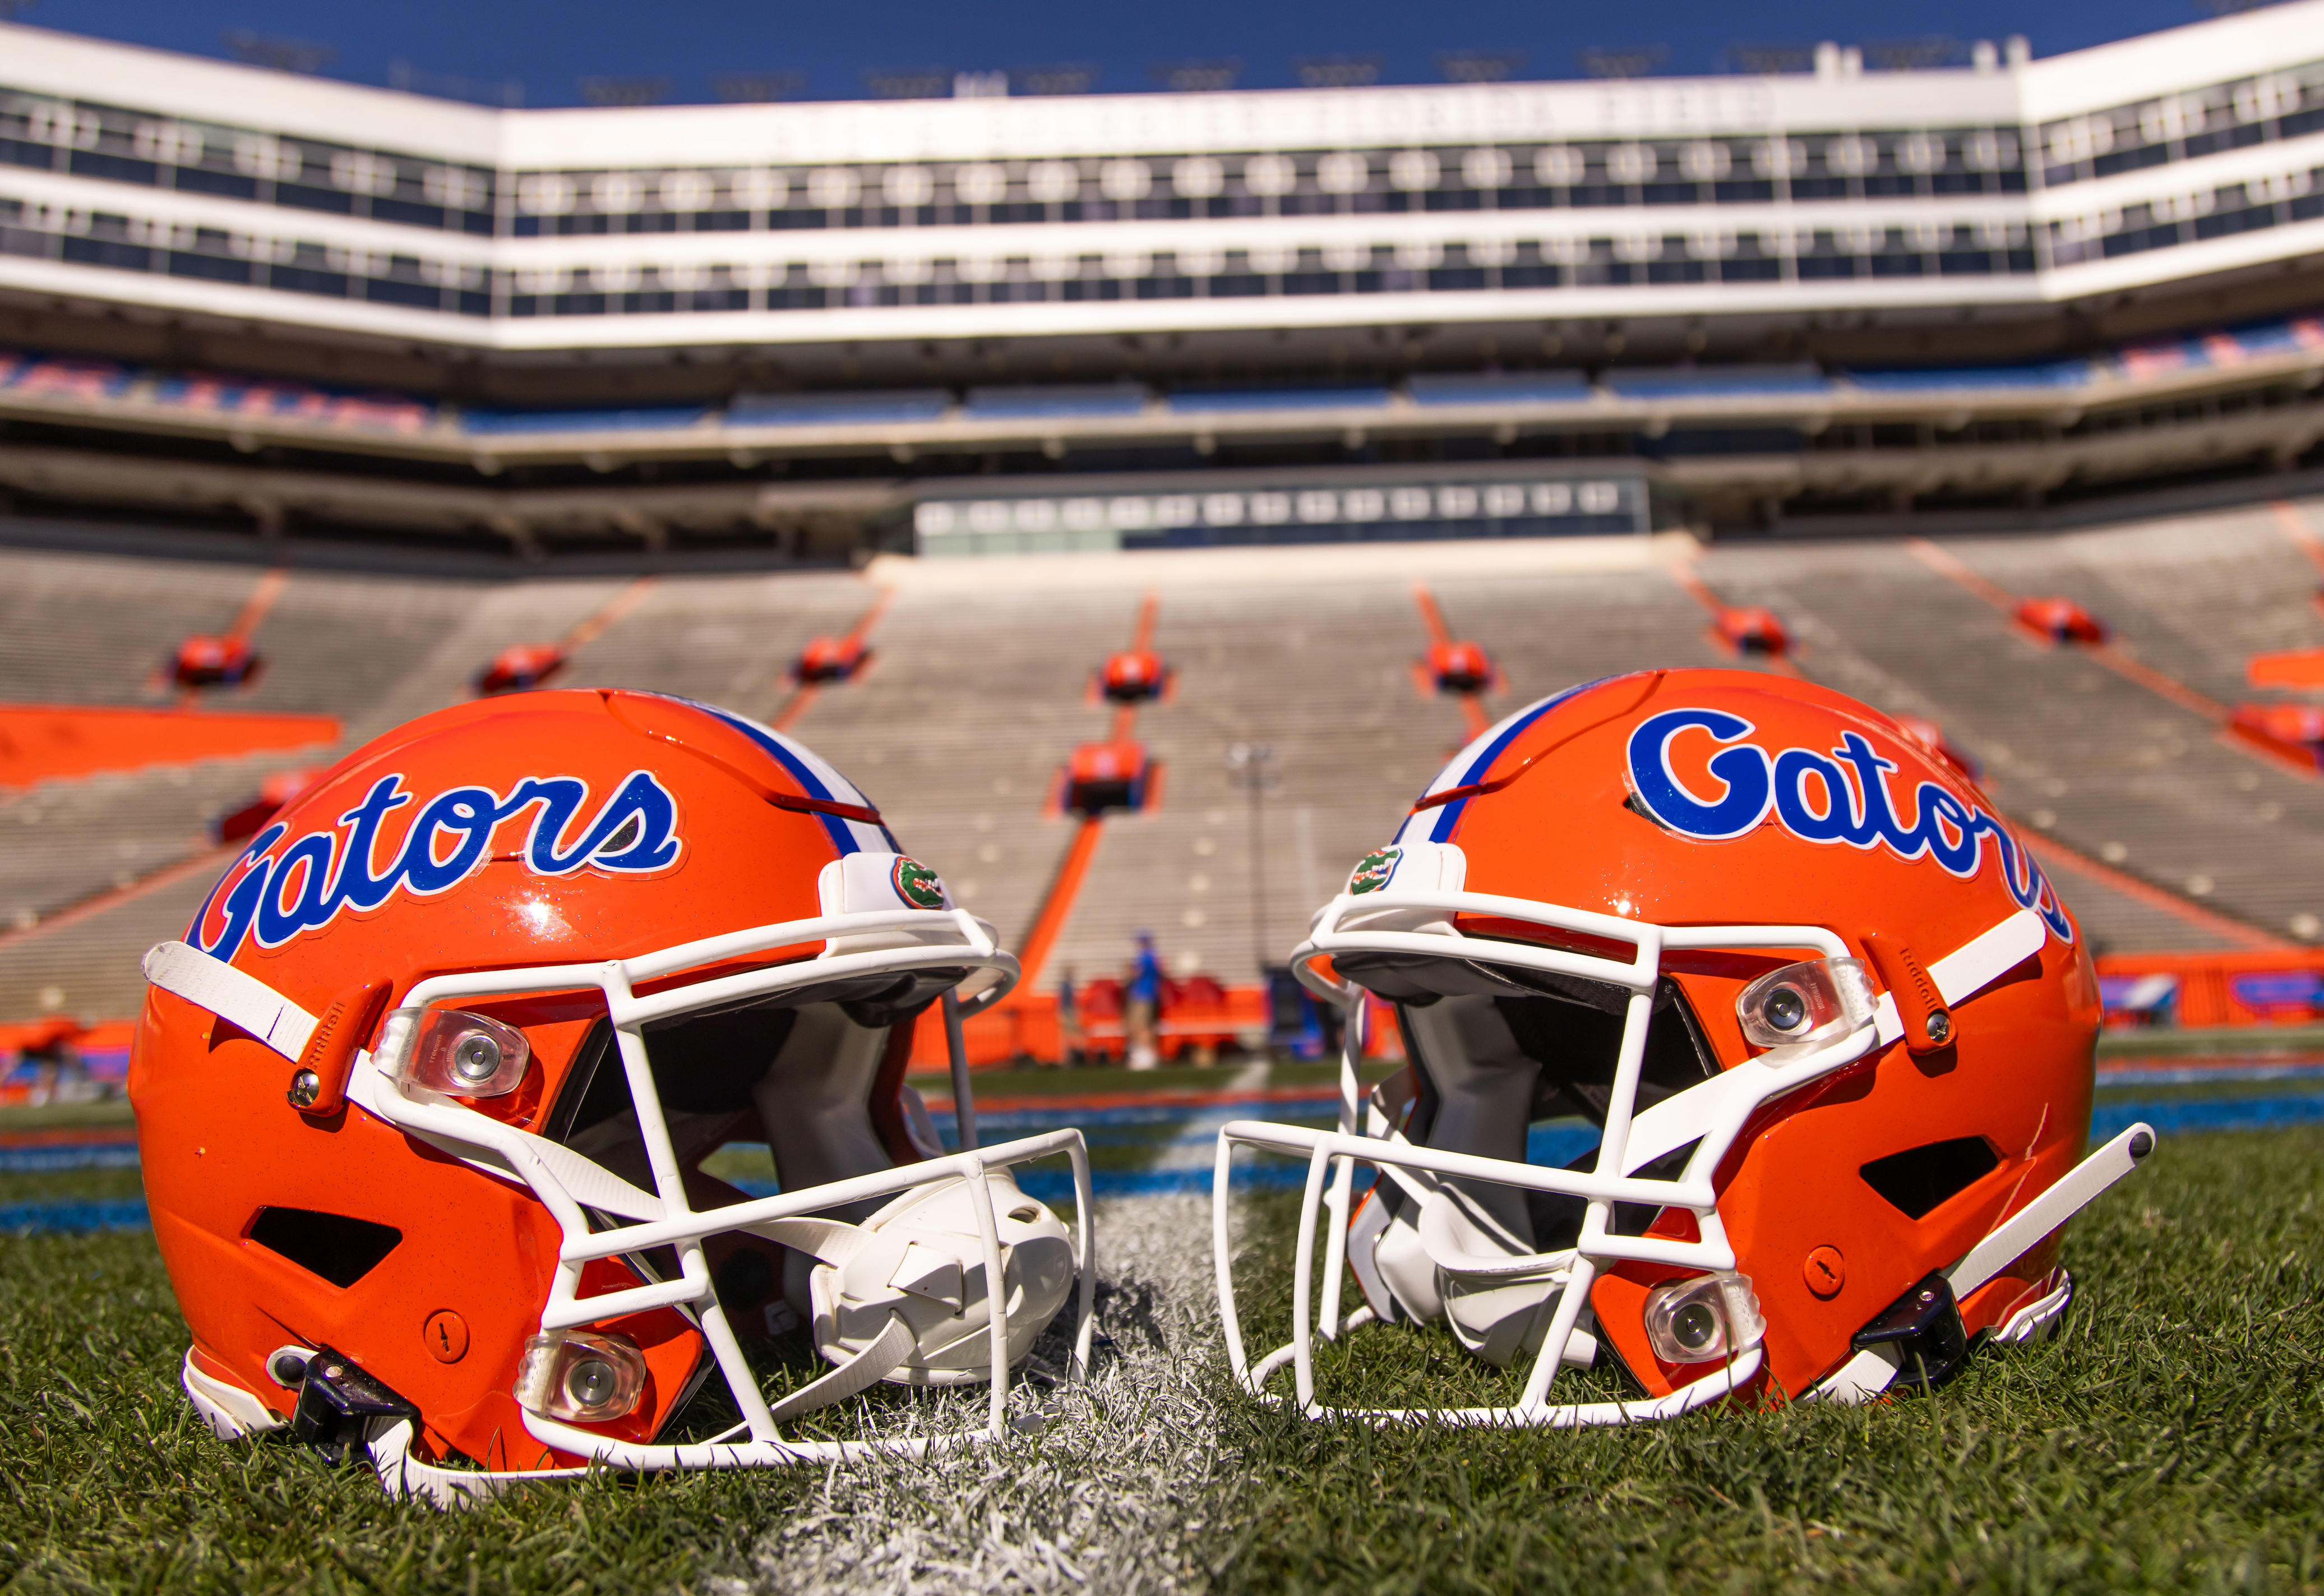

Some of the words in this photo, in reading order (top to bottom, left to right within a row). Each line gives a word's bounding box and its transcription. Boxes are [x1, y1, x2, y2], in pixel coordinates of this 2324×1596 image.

[184, 769, 682, 964] Gators
[1627, 708, 2074, 944] Gators
[303, 1002, 345, 1069] Riddell
[1900, 948, 1938, 1009] Riddell
